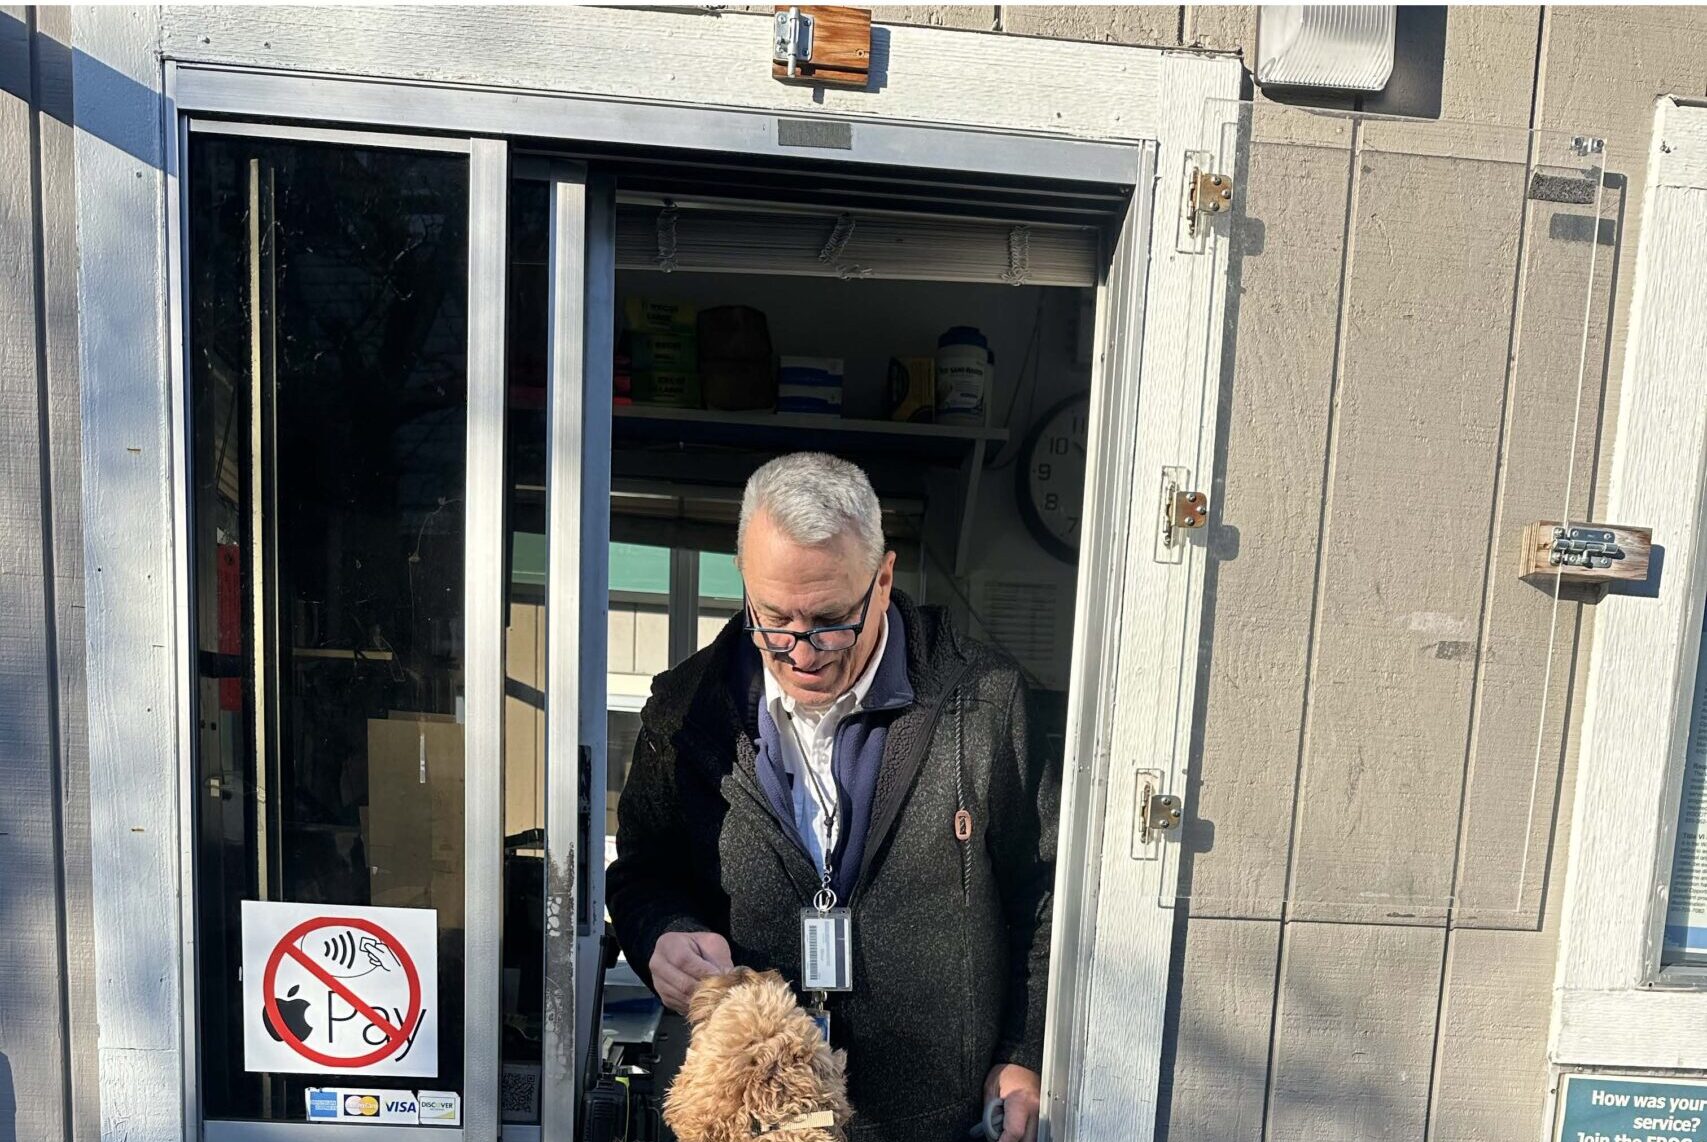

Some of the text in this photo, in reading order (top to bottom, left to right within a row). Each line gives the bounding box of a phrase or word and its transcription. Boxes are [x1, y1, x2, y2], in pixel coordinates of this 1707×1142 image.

[1050, 437, 1068, 455] 10
[1038, 463, 1051, 481] 9
[1044, 493, 1057, 511] 8
[1067, 516, 1079, 533] 7
[329, 990, 427, 1062] Pay
[386, 1102, 416, 1113] VISA
[1592, 1090, 1707, 1113] How was your
[1633, 1116, 1701, 1132] service?
